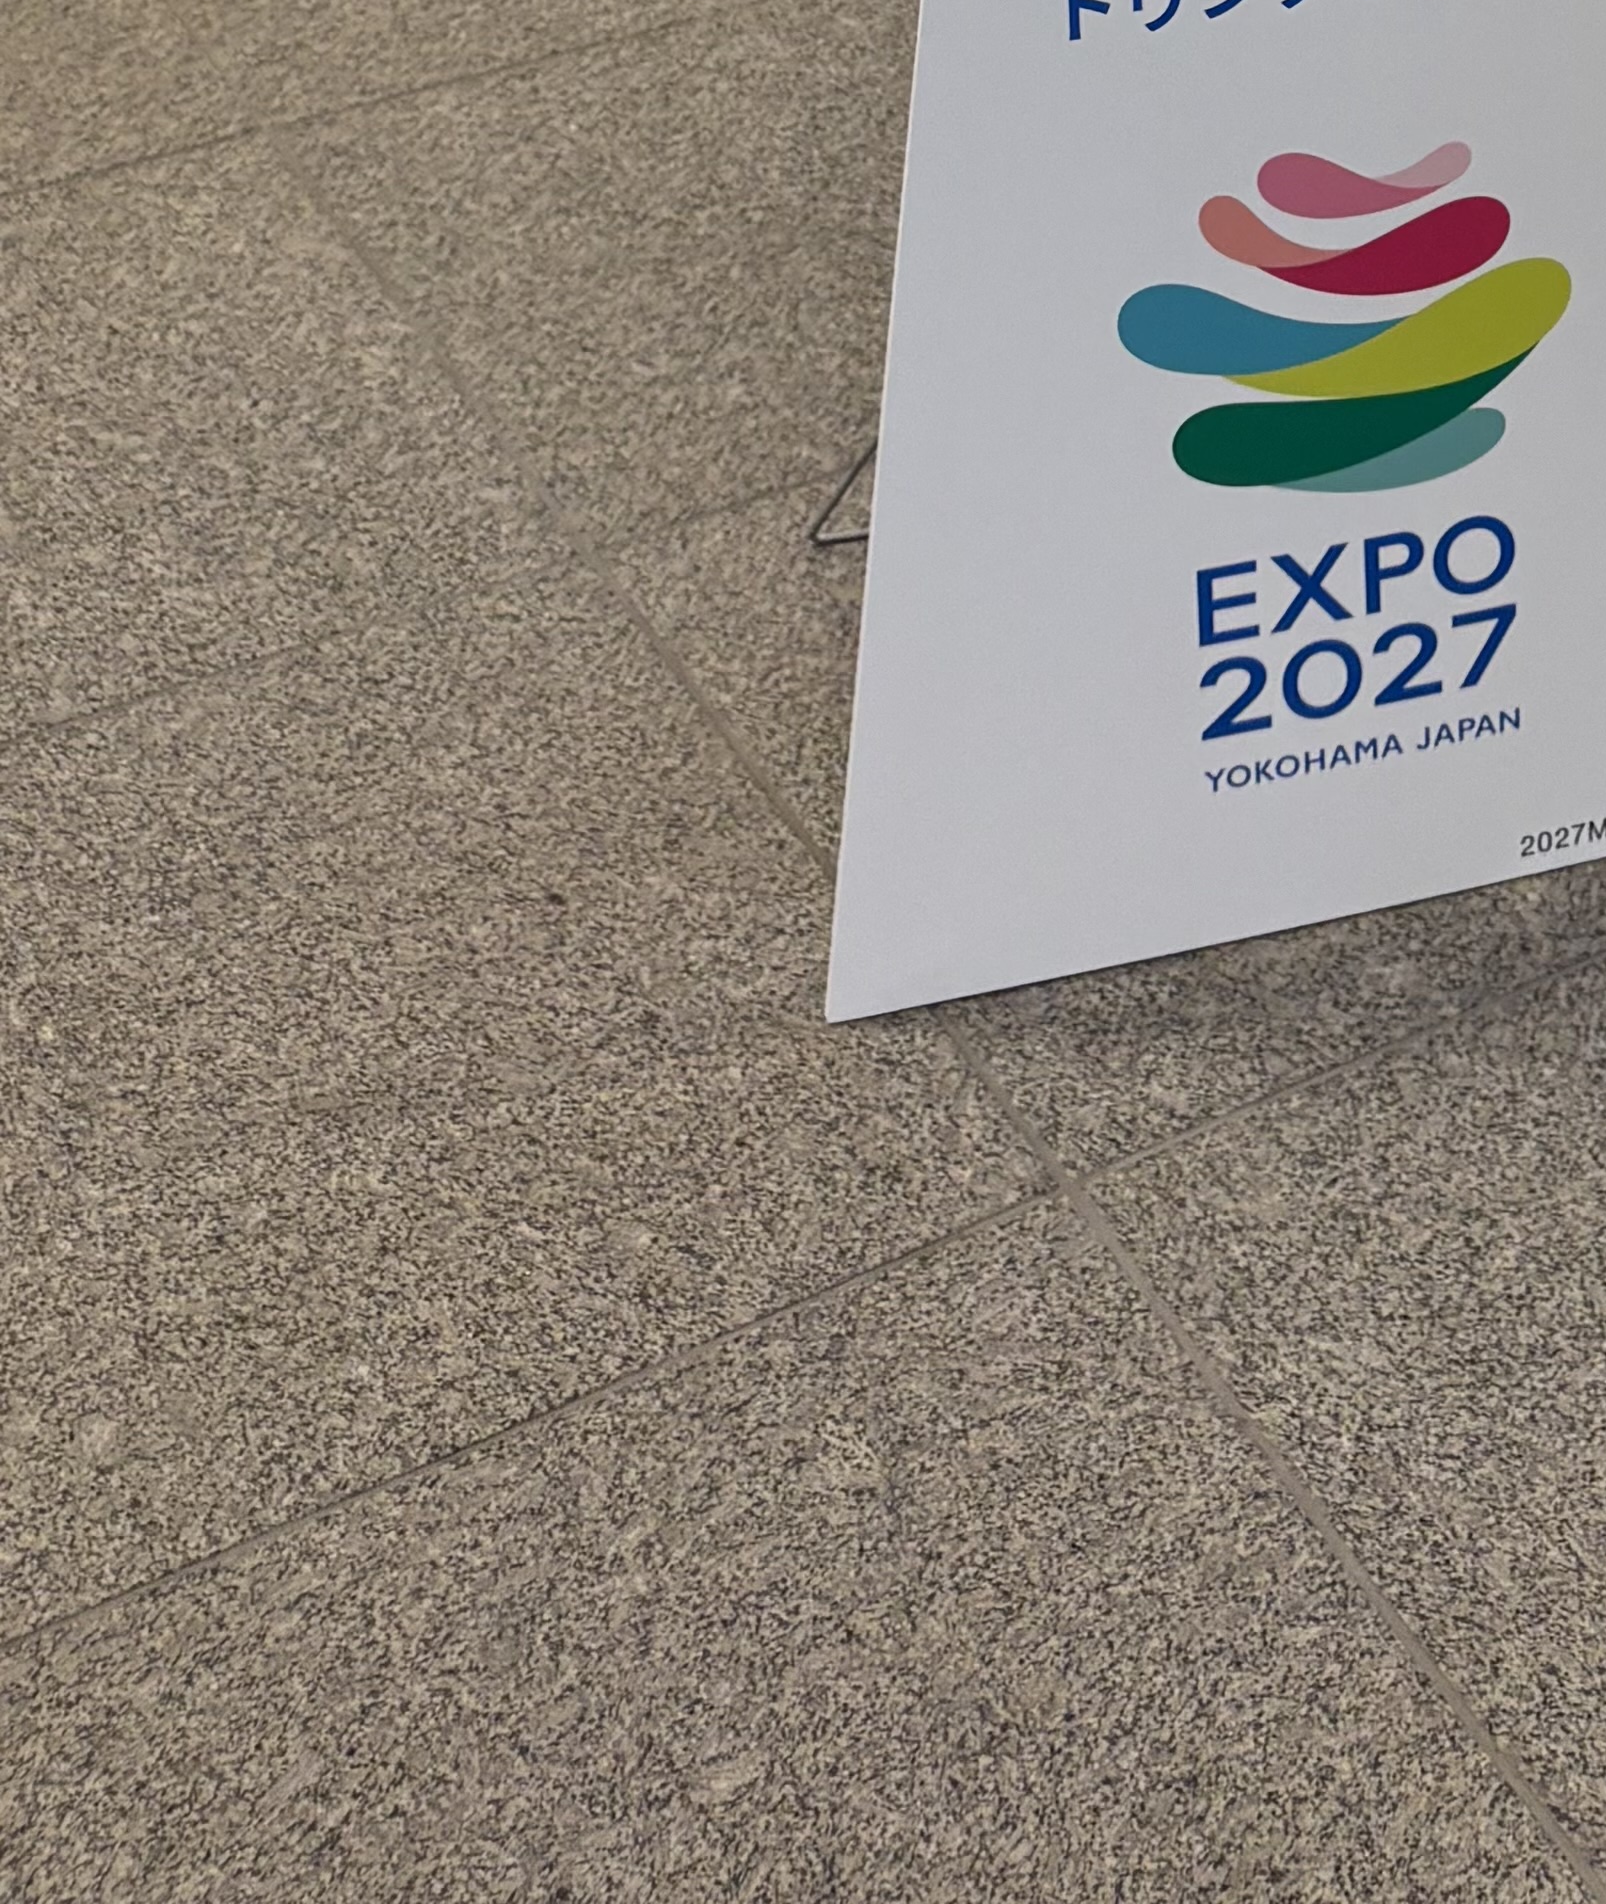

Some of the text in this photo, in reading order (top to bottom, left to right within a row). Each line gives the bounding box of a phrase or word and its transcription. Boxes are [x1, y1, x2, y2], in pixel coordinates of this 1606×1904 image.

[1195, 514, 1517, 648] EXPO
[1200, 602, 1518, 742] 2027
[1204, 706, 1522, 793] YOKOHAMA JAPAN
